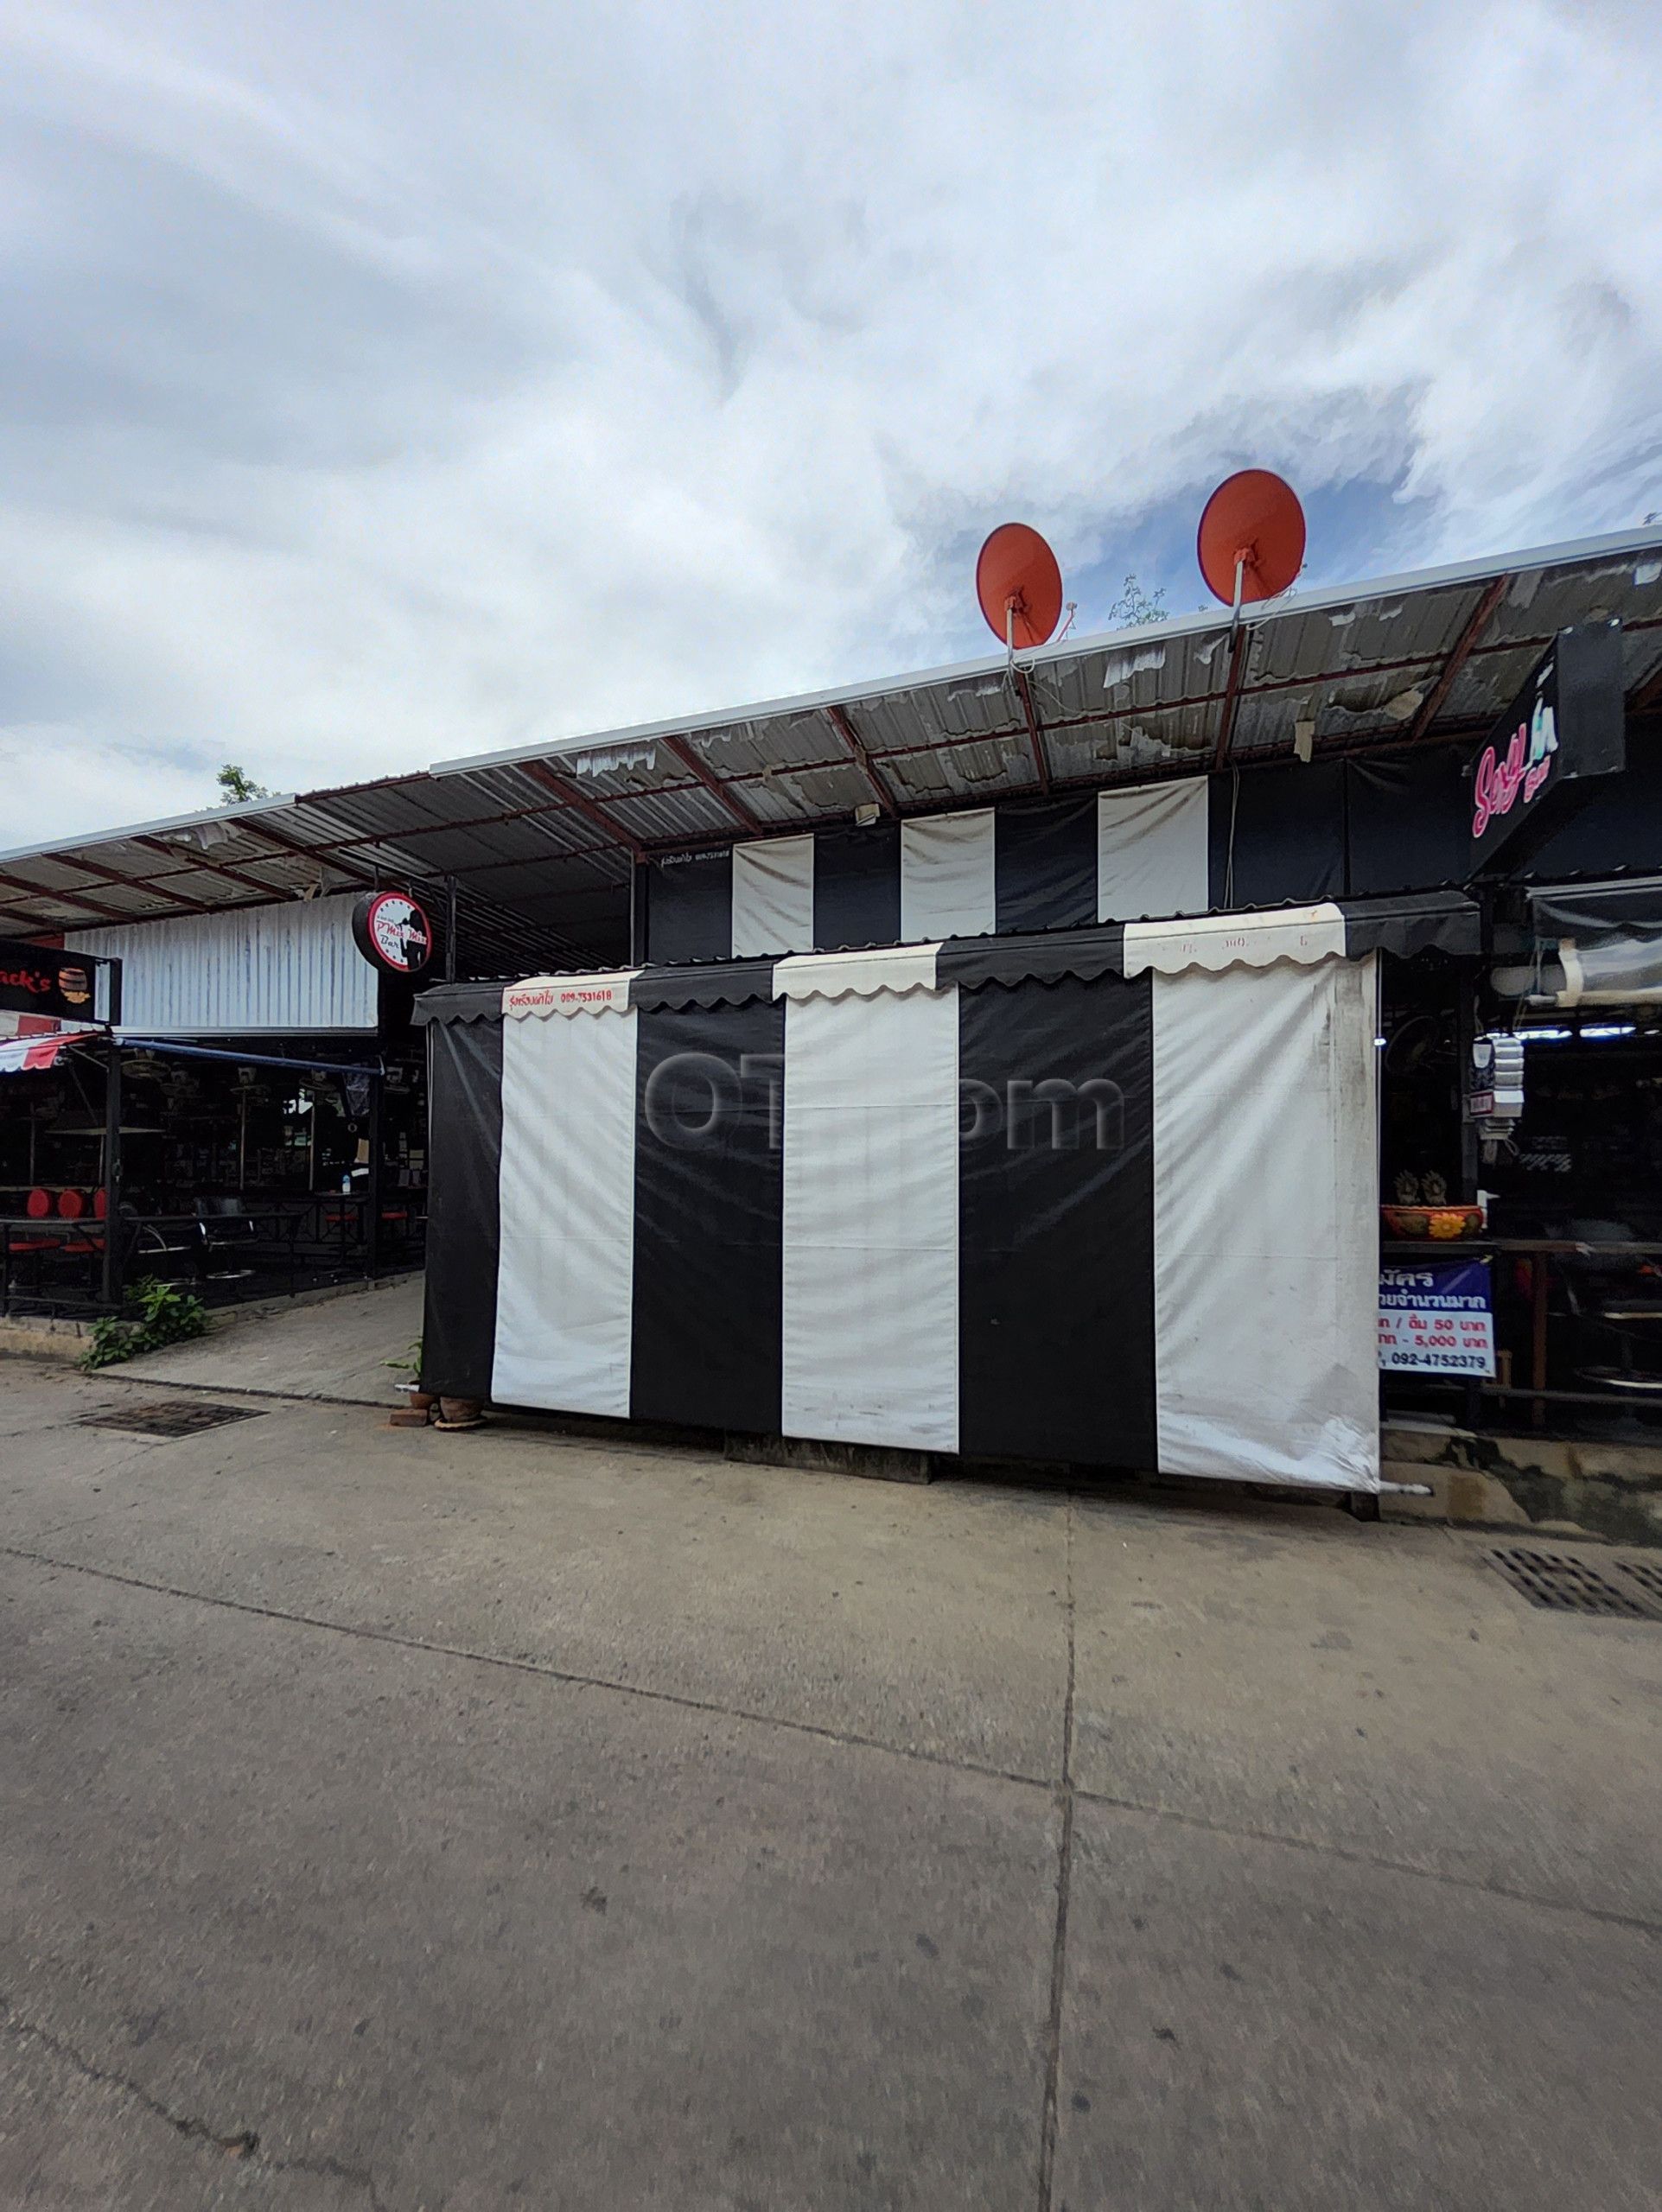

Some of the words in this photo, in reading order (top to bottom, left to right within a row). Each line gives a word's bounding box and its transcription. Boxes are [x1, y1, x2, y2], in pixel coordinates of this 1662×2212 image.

[380, 934, 399, 949] Bar
[1434, 1319, 1455, 1331] 50
[1415, 1334, 1457, 1349] 5,000
